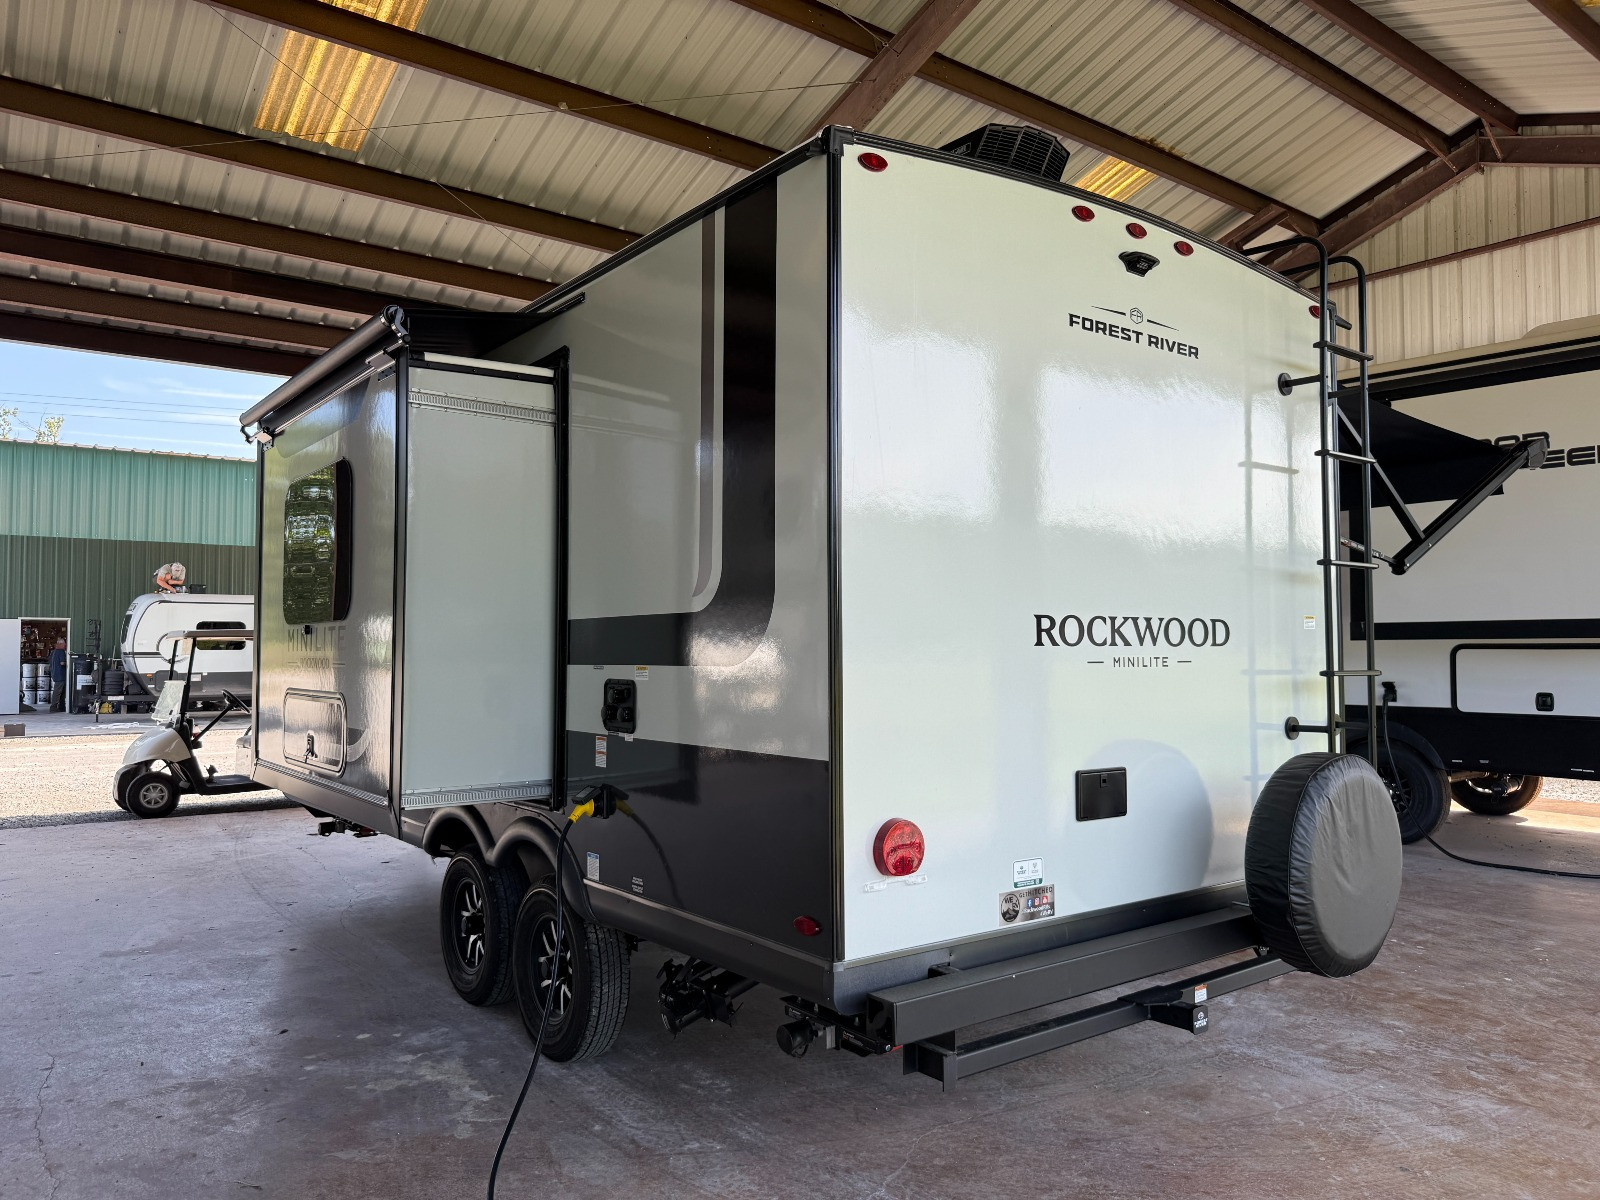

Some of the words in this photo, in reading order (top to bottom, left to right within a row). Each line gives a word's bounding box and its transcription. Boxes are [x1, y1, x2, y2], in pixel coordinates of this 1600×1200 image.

[1068, 313, 1143, 344] FOREST
[1147, 334, 1199, 359] RIVER
[1034, 614, 1230, 647] ROCKWOOD
[1113, 656, 1169, 668] MINILITE
